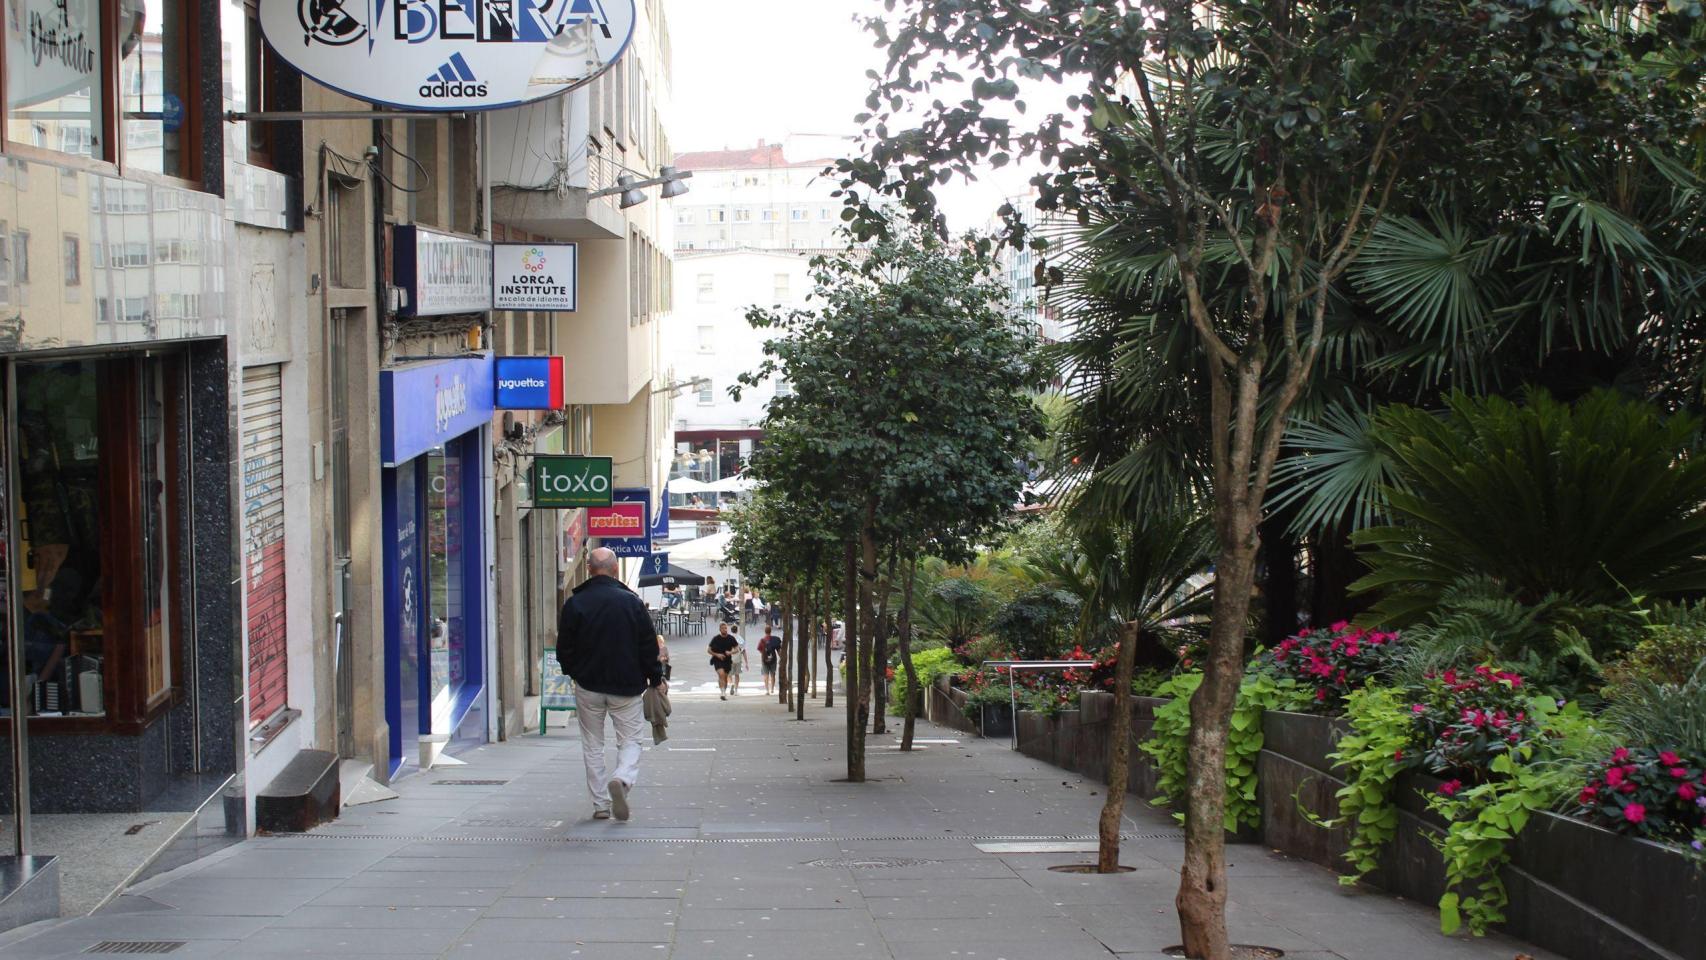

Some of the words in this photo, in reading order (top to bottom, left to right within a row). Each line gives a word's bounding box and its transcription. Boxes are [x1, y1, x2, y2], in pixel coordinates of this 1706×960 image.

[418, 81, 487, 98] adidas
[512, 275, 554, 284] LORCA
[501, 285, 566, 295] INSTITUTE
[498, 377, 545, 390] juguettos
[539, 463, 608, 493] toxo
[590, 513, 640, 528] revitex
[633, 545, 649, 553] VAL
